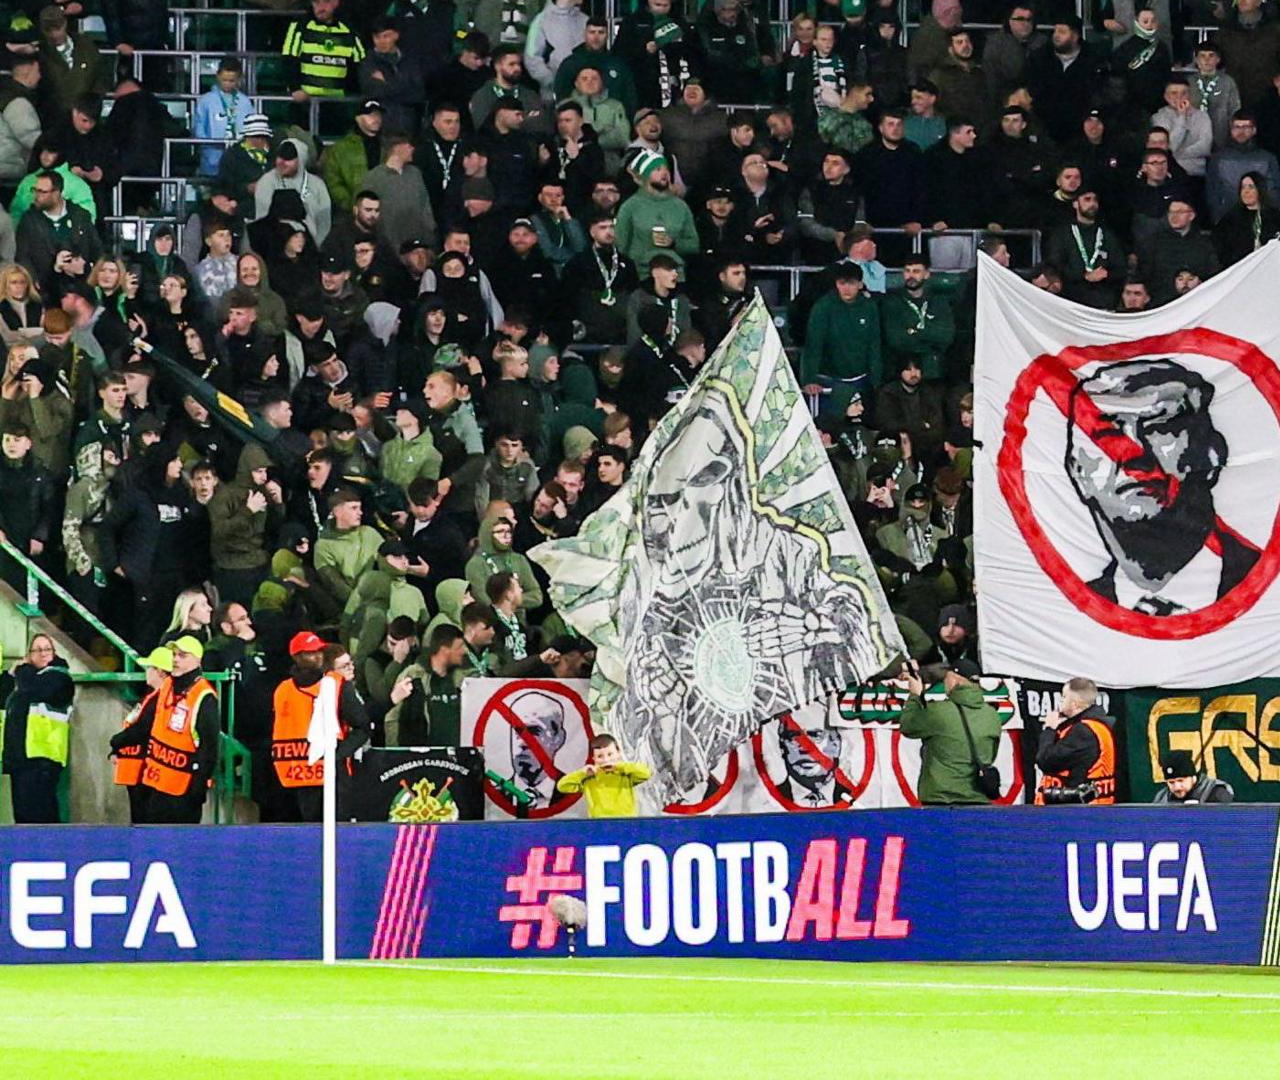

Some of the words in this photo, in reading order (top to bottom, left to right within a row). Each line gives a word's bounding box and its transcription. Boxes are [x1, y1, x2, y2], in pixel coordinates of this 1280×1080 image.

[9, 861, 197, 949] EFA
[498, 837, 910, 950] #FOOTBALL
[1066, 841, 1218, 932] UEFA
